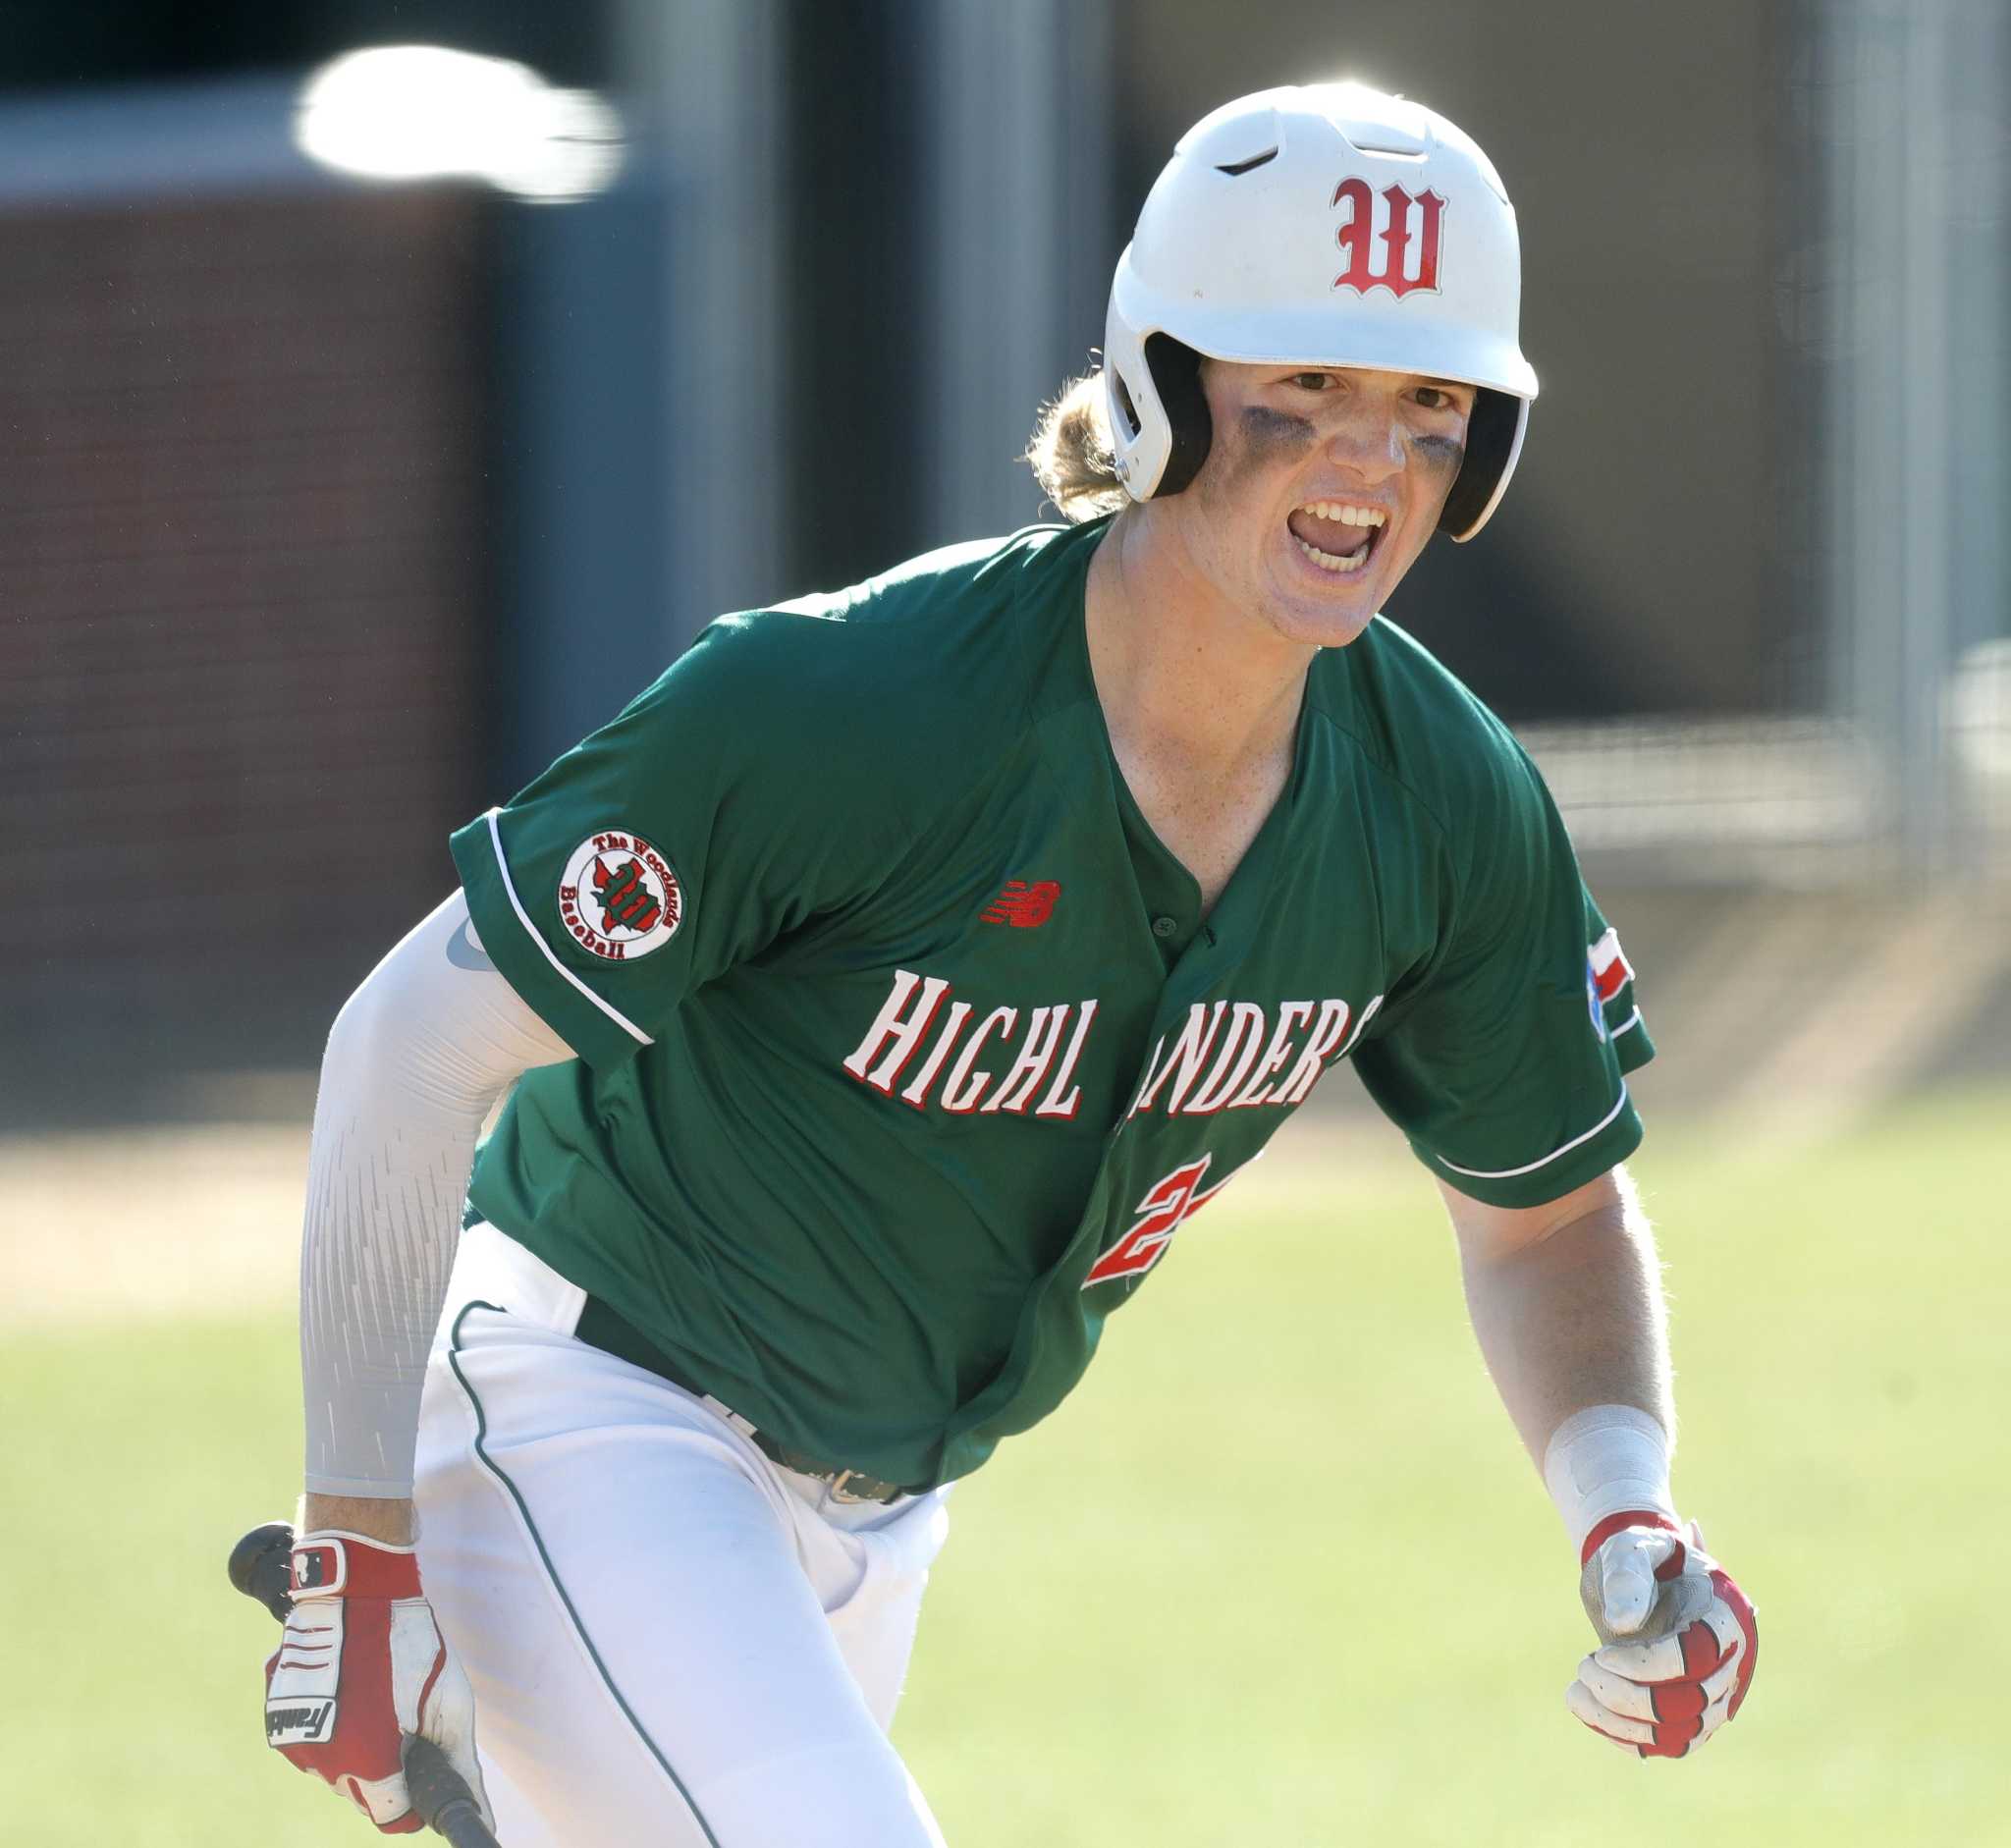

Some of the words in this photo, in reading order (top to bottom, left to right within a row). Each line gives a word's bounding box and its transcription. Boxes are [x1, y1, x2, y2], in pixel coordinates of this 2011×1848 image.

[1330, 175, 1449, 303] W
[560, 885, 625, 959] Baseball
[591, 833, 629, 852] The
[632, 837, 680, 929] Woodlands
[1080, 1151, 1265, 1291] 2
